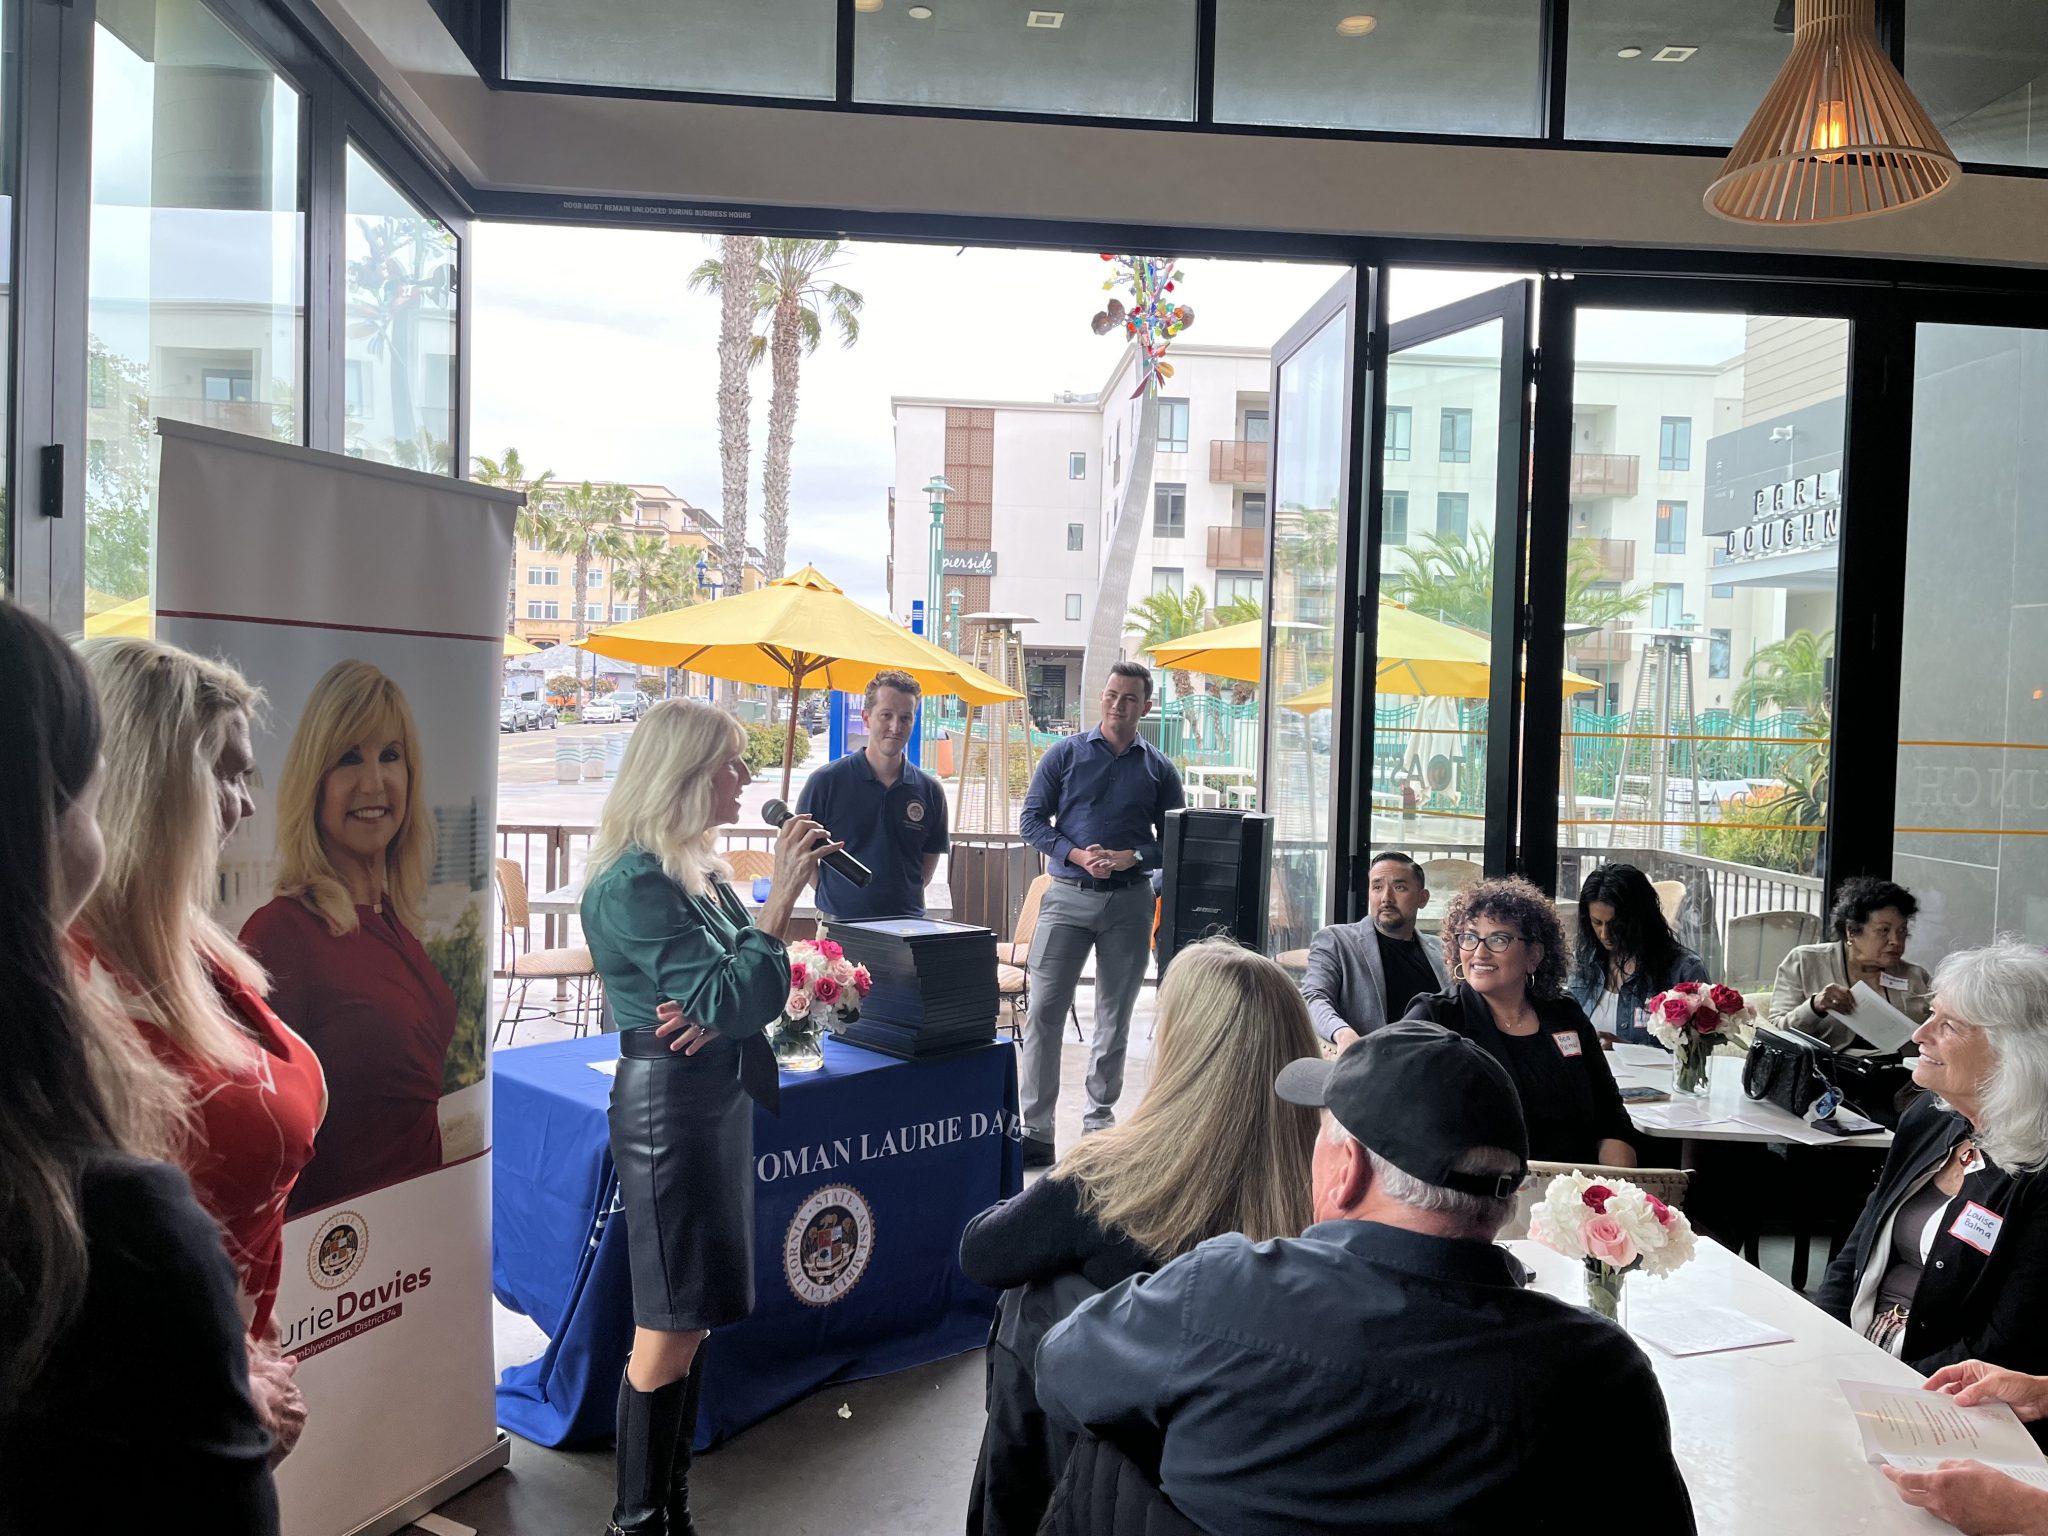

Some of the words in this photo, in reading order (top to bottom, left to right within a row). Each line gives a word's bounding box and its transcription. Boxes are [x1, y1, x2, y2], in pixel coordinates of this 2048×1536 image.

[563, 201, 582, 209] DOOR
[583, 202, 602, 210] MUST
[604, 203, 631, 212] REMAIN
[631, 205, 667, 215] UNLOCKED
[668, 207, 694, 216] DURING
[694, 209, 728, 218] BUSINESS
[728, 211, 752, 219] HOURS
[1754, 472, 1840, 516] PARL
[1725, 508, 1838, 556] DOUGHN
[754, 1137, 851, 1183] OMAN
[860, 1115, 963, 1161] LAURIE
[814, 1191, 856, 1209] STATE
[1966, 1209, 1995, 1229] Louise
[1964, 1217, 1992, 1240] Balma
[788, 1215, 826, 1300] CALIFORNIA
[279, 1266, 433, 1349] urieDavies
[295, 1328, 353, 1360] mblywoman,
[354, 1314, 385, 1333] District
[386, 1308, 397, 1318] 74
